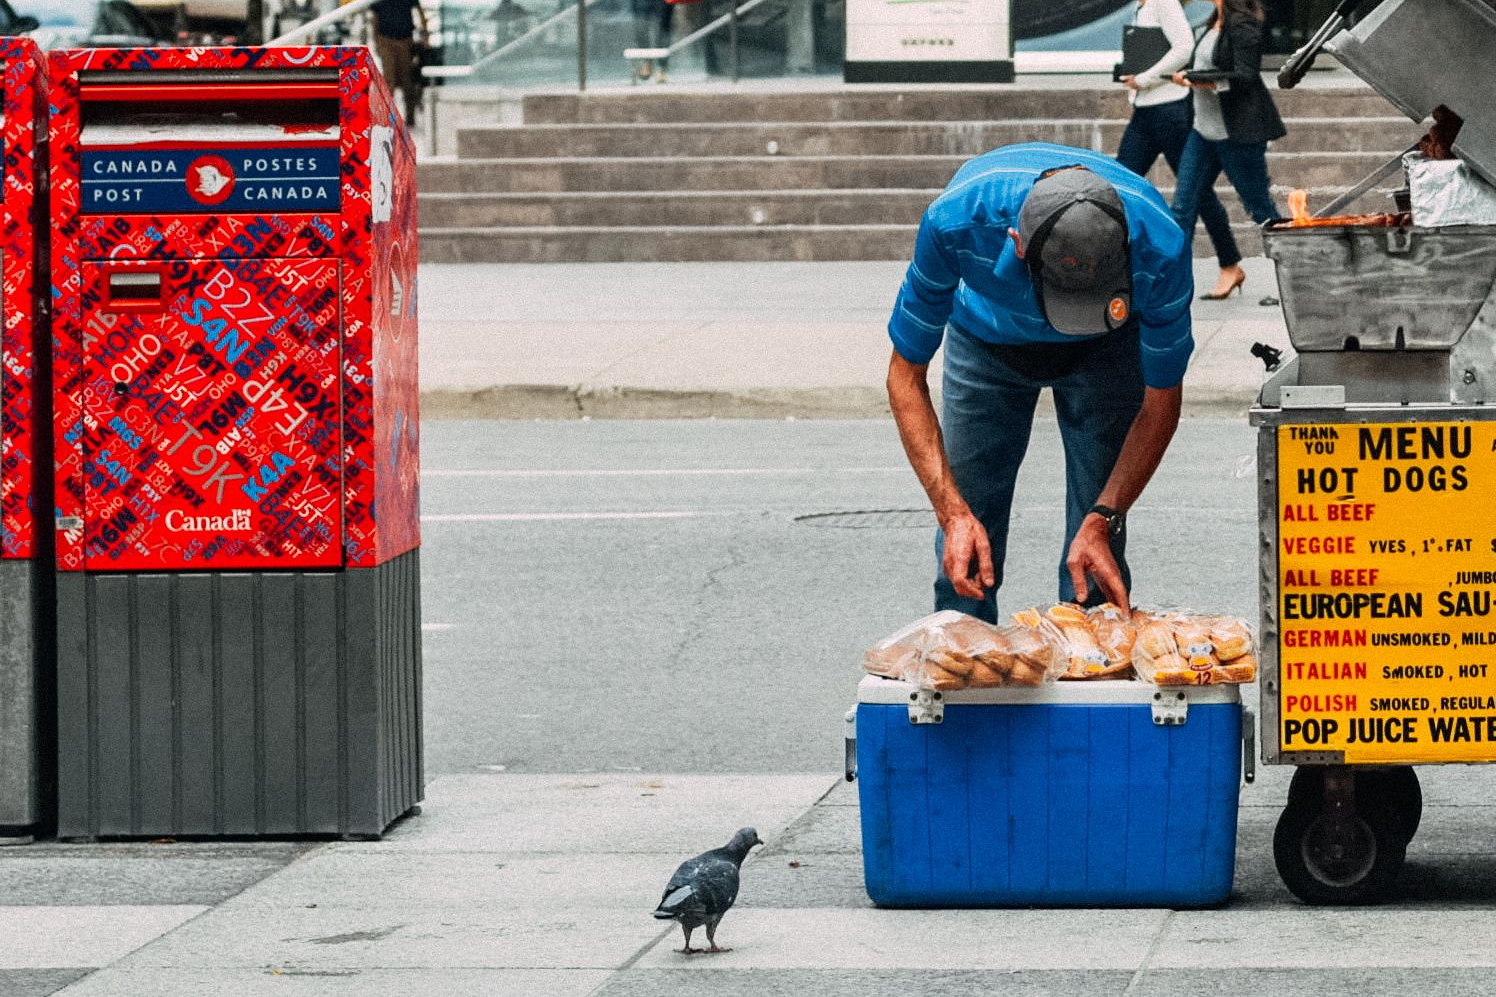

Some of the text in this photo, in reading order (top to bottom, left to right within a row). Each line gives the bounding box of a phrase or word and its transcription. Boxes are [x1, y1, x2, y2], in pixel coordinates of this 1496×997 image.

[93, 158, 318, 174] CANADA POSTES
[94, 186, 328, 202] POST CANADA
[203, 269, 275, 339] B2Z
[182, 298, 250, 364] S4N
[163, 381, 197, 408] J5T
[278, 364, 335, 420] H9X
[1305, 442, 1335, 454] YOU
[1359, 426, 1472, 461] MENU
[167, 419, 244, 504] T9K
[241, 451, 296, 502] K4A
[1298, 465, 1469, 493] HOT DOGS
[165, 509, 252, 532] Canada
[292, 499, 323, 523] J5T
[1284, 503, 1376, 521] ALL BEEF
[1284, 536, 1355, 554] VEGGIE
[1446, 539, 1472, 552] FAT
[1285, 570, 1320, 587] ALL
[1331, 569, 1379, 586] BEEF
[1284, 592, 1423, 620] EUROPEAN
[1284, 630, 1367, 648] GERMAN
[1287, 662, 1367, 680] ITALIAN
[1459, 664, 1488, 677] HOT
[1287, 695, 1357, 713] POLISH
[1285, 718, 1338, 744] POP
[1347, 718, 1418, 744] JUICE
